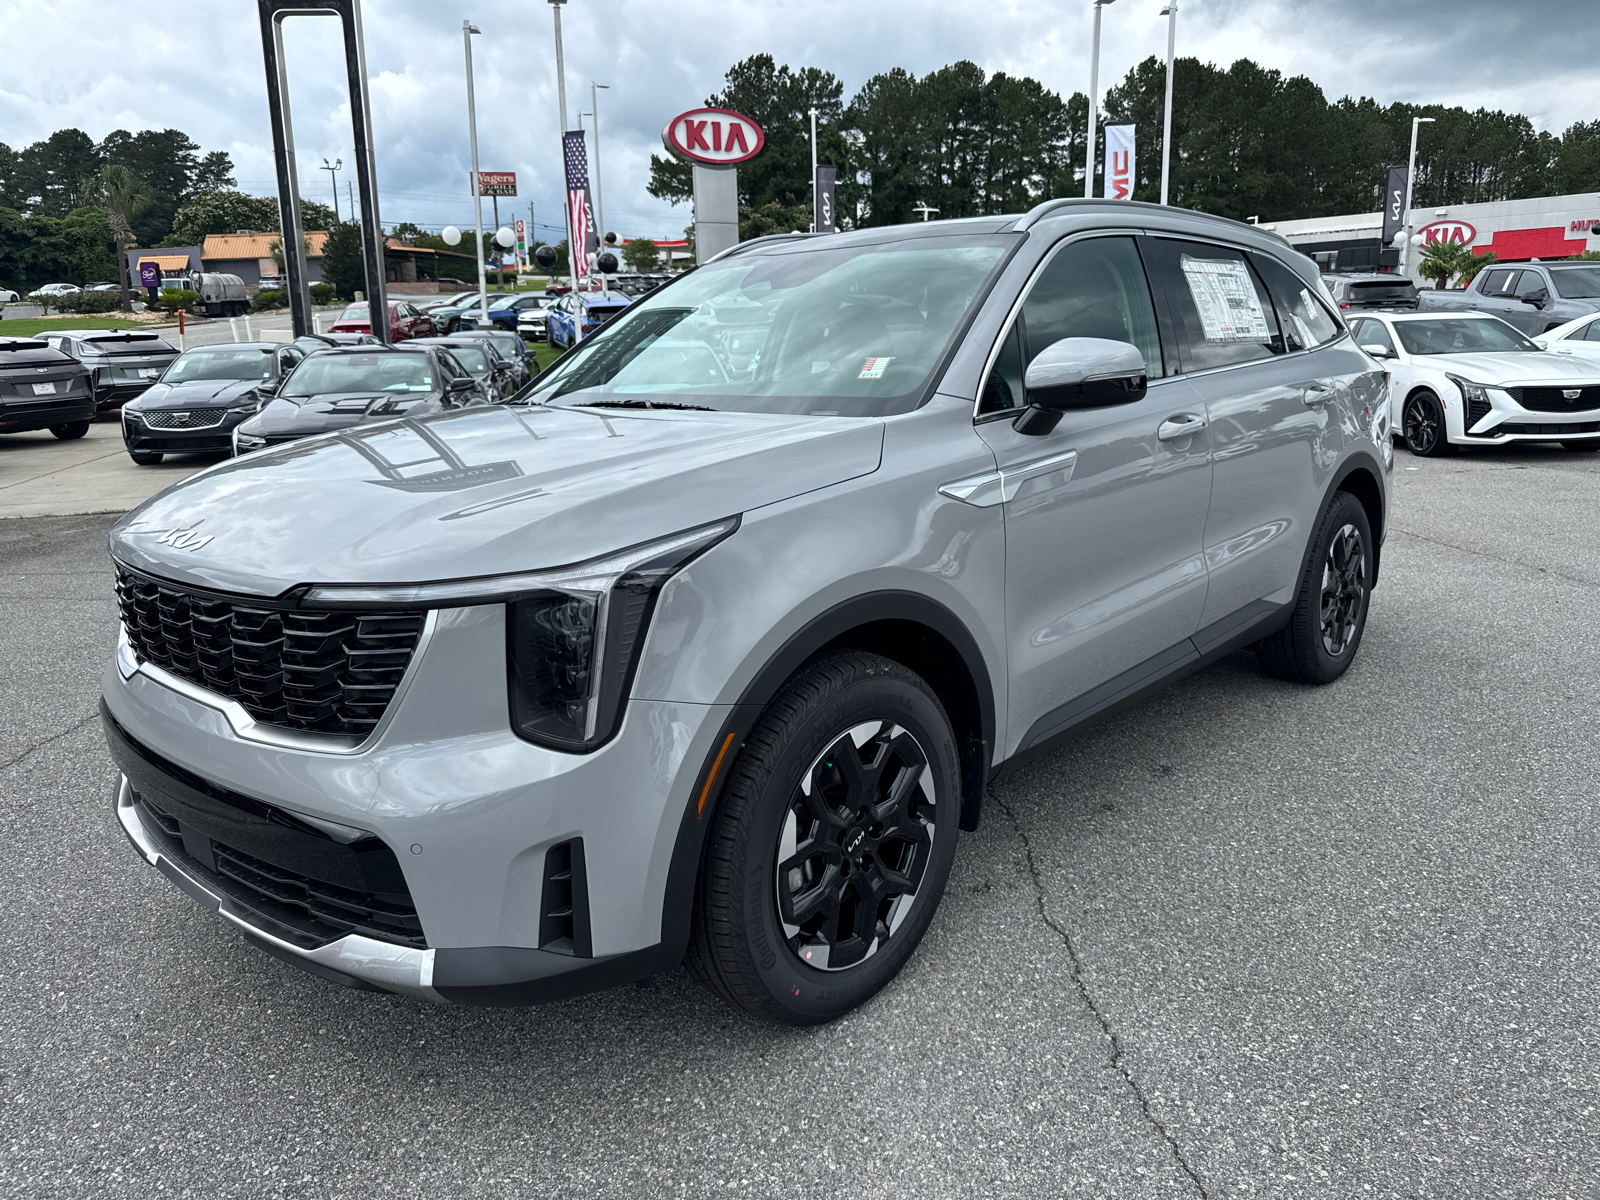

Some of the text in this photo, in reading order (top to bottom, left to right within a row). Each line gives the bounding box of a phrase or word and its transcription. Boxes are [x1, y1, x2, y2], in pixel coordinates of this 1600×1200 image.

[684, 119, 749, 153] KIA
[1425, 226, 1465, 245] KIA
[155, 527, 215, 552] KIA
[847, 830, 865, 853] KIA
[748, 880, 777, 971] Continental
